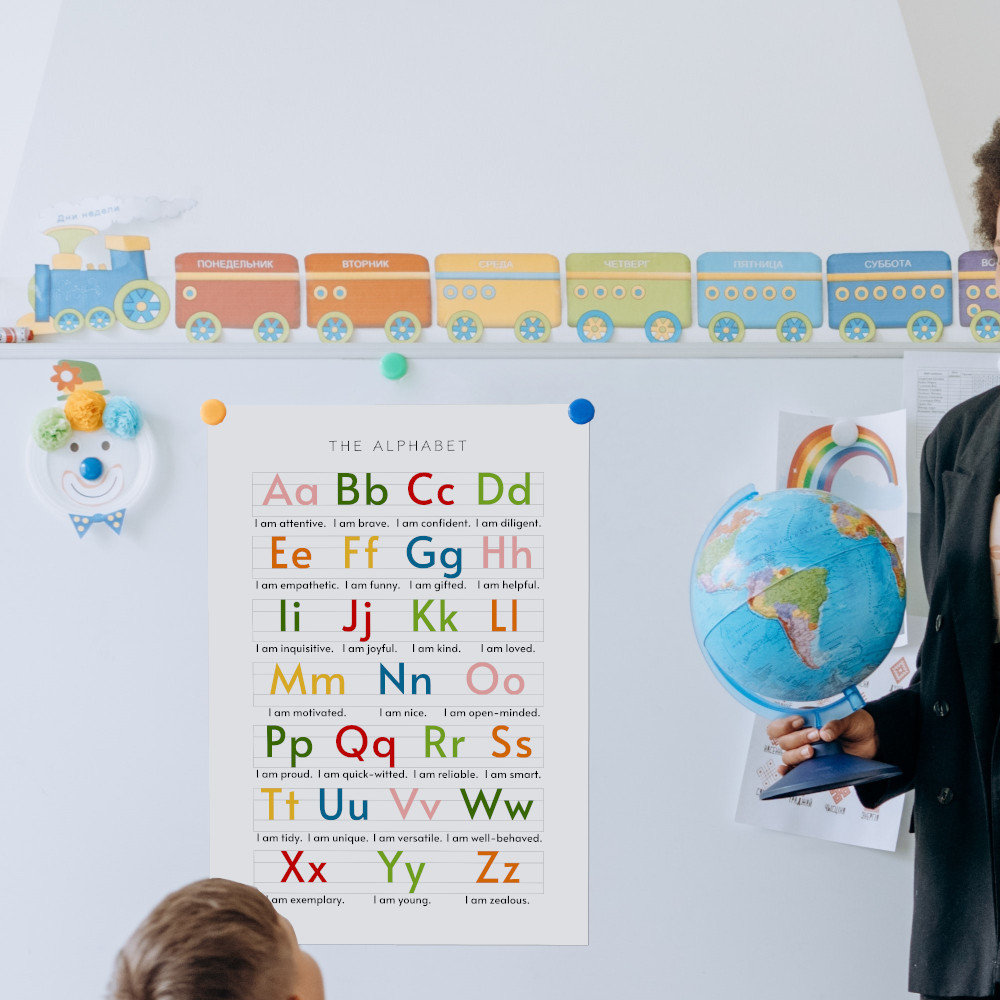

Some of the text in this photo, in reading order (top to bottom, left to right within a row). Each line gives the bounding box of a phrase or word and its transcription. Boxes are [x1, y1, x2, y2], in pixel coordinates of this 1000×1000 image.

[197, 259, 274, 269] ПОНЕДЕЛЬНИК
[341, 259, 390, 269] ВТОРНИК
[477, 260, 514, 269] СРЕДА
[603, 259, 650, 269] ЧЕТВЕРГ
[733, 259, 784, 270] ПЯТНИЦА
[864, 259, 912, 269] СУББОТА
[328, 439, 467, 452] THE ALPHABET
[263, 471, 531, 505] Aa Bb Cc Dd
[279, 518, 327, 528] attentive.
[358, 518, 390, 528] brave.
[420, 517, 471, 528] confident.
[481, 520, 498, 528] am
[500, 517, 542, 530] diligent.
[272, 535, 532, 578] Ee Ff Gg Hh
[261, 582, 278, 590] am
[280, 580, 340, 592] empathetic.
[350, 582, 368, 590] am
[369, 579, 401, 593] funny.
[414, 582, 432, 590] am
[433, 579, 467, 592] gifted.
[483, 582, 500, 590] am
[502, 579, 540, 592] helpful.
[342, 598, 372, 642] Jj
[413, 599, 459, 631] Kk
[280, 644, 334, 656] inquisitive.
[365, 643, 398, 656] joyful.
[436, 643, 462, 653] kind.
[505, 643, 536, 653] loved.
[270, 662, 525, 695] Mm Nn Oo
[292, 707, 347, 718] motivated.
[404, 708, 427, 718] nice.
[449, 710, 466, 718] am
[468, 707, 541, 720] open-minded.
[267, 724, 533, 768] Pp Qq Rr Ss
[261, 771, 278, 779] am
[280, 769, 313, 781] proud.
[323, 771, 340, 779] am
[342, 769, 408, 782] quick-witted.
[437, 769, 479, 779] reliable.
[509, 770, 542, 779] smart.
[261, 787, 534, 820] Tt Uu Vv Ww
[262, 835, 279, 843] am
[281, 833, 303, 845] tidy.
[313, 835, 330, 843] am
[332, 833, 369, 845] unique.
[378, 835, 396, 843] am
[397, 833, 443, 843] versatile.
[451, 835, 469, 843] am
[470, 833, 543, 843] well-behaved.
[281, 850, 521, 893] Xx Yy Zz
[290, 894, 345, 907] exemplary.
[379, 897, 396, 905] am
[397, 897, 432, 907] young.
[470, 897, 488, 905] am
[489, 895, 530, 905] zealous.
